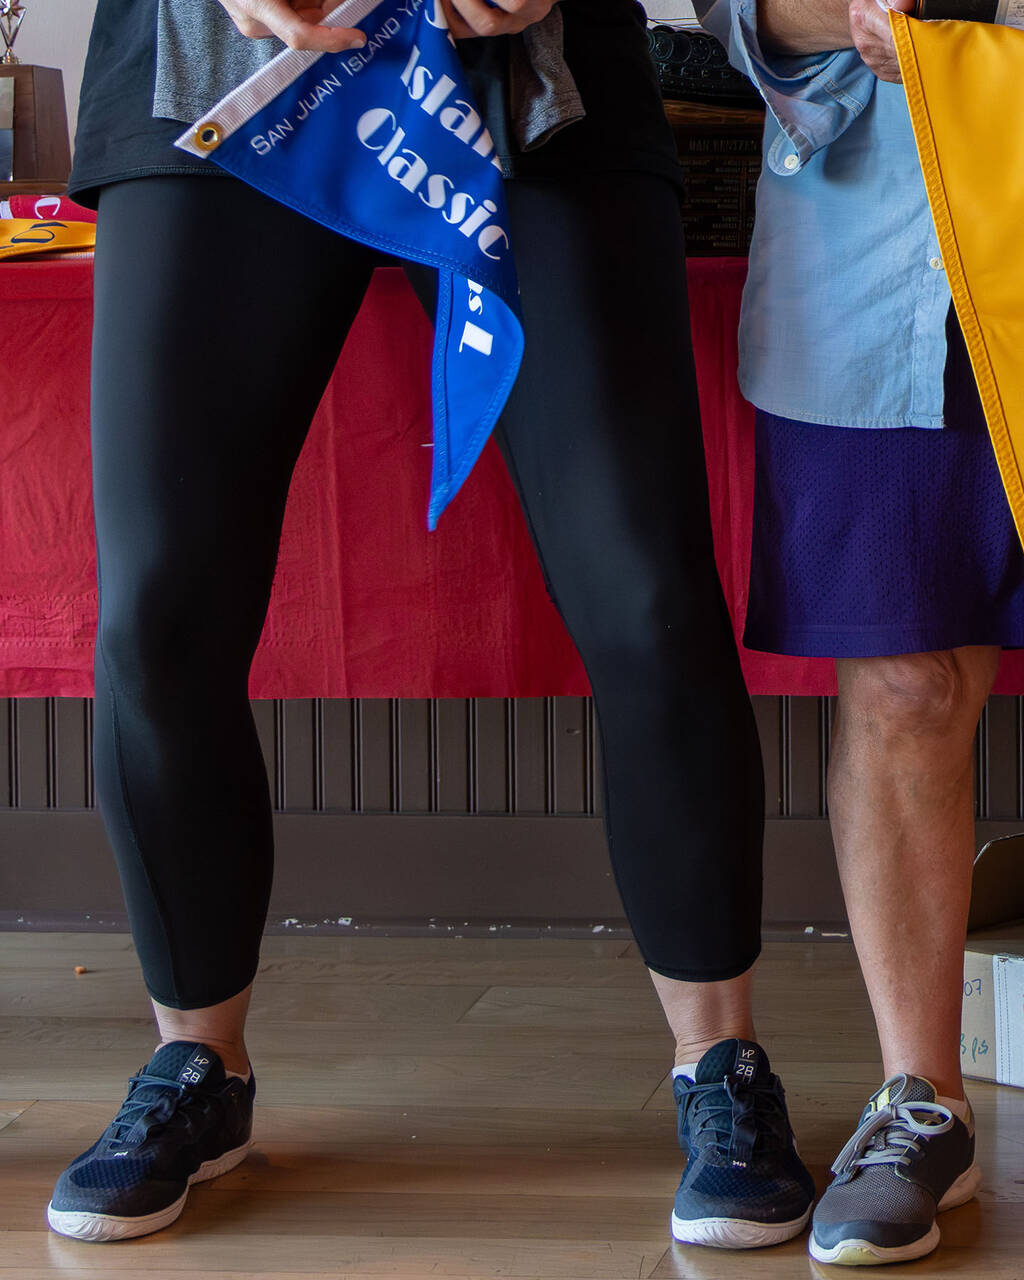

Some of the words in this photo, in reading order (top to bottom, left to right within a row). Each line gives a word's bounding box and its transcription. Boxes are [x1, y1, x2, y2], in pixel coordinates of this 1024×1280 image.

[250, 118, 294, 156] SAN
[296, 73, 342, 120] JUAN
[340, 17, 400, 77] ISLAND
[356, 108, 509, 260] Classic
[182, 1068, 200, 1083] 28
[736, 1064, 754, 1076] 28
